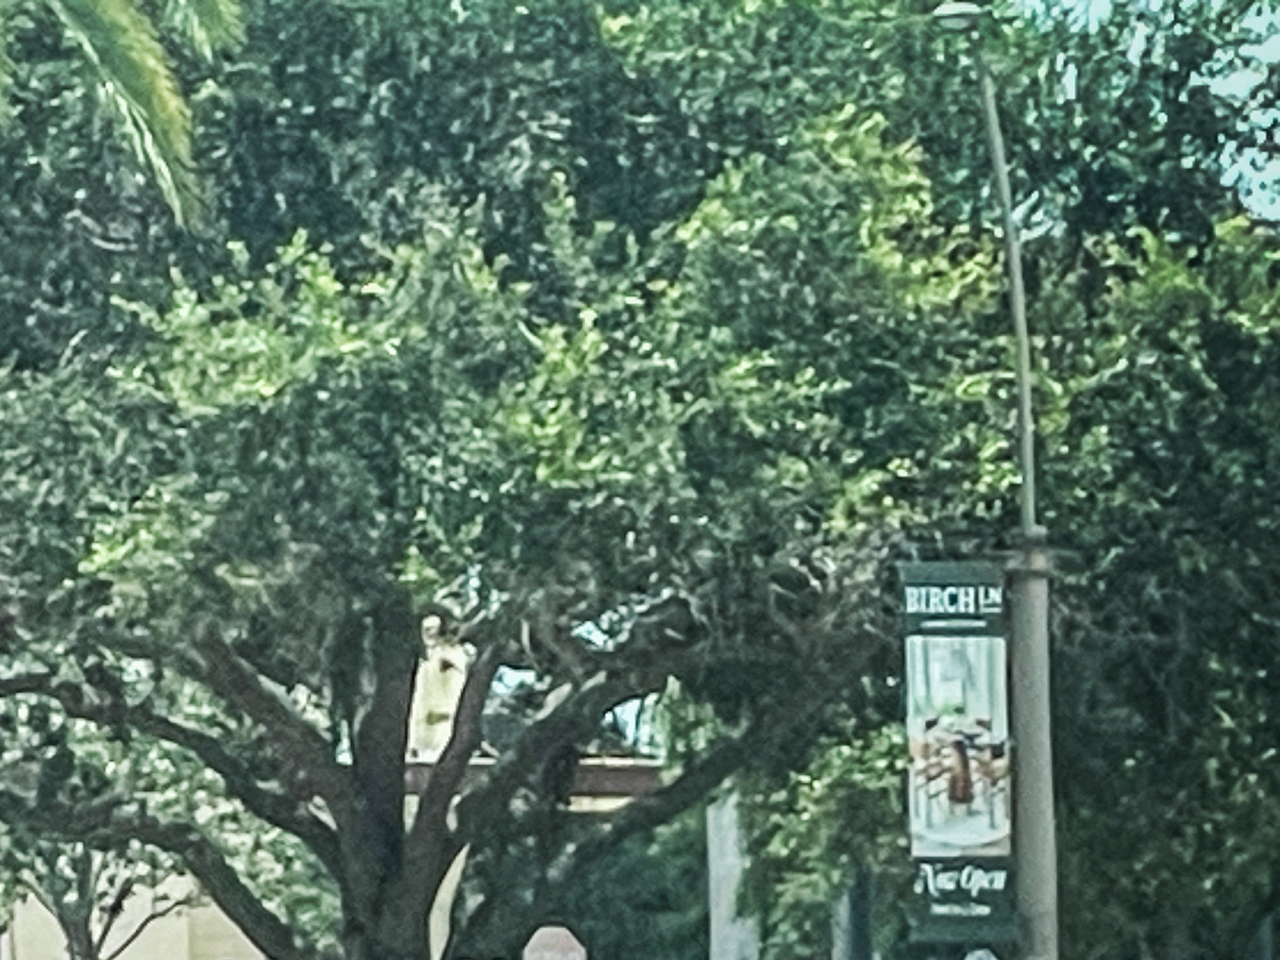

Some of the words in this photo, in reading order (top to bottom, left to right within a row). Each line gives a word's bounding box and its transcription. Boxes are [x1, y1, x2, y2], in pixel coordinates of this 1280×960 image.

[905, 586, 975, 613] BIRCH
[978, 586, 1002, 613] LN
[913, 863, 959, 897] Now
[961, 865, 1007, 897] Open
